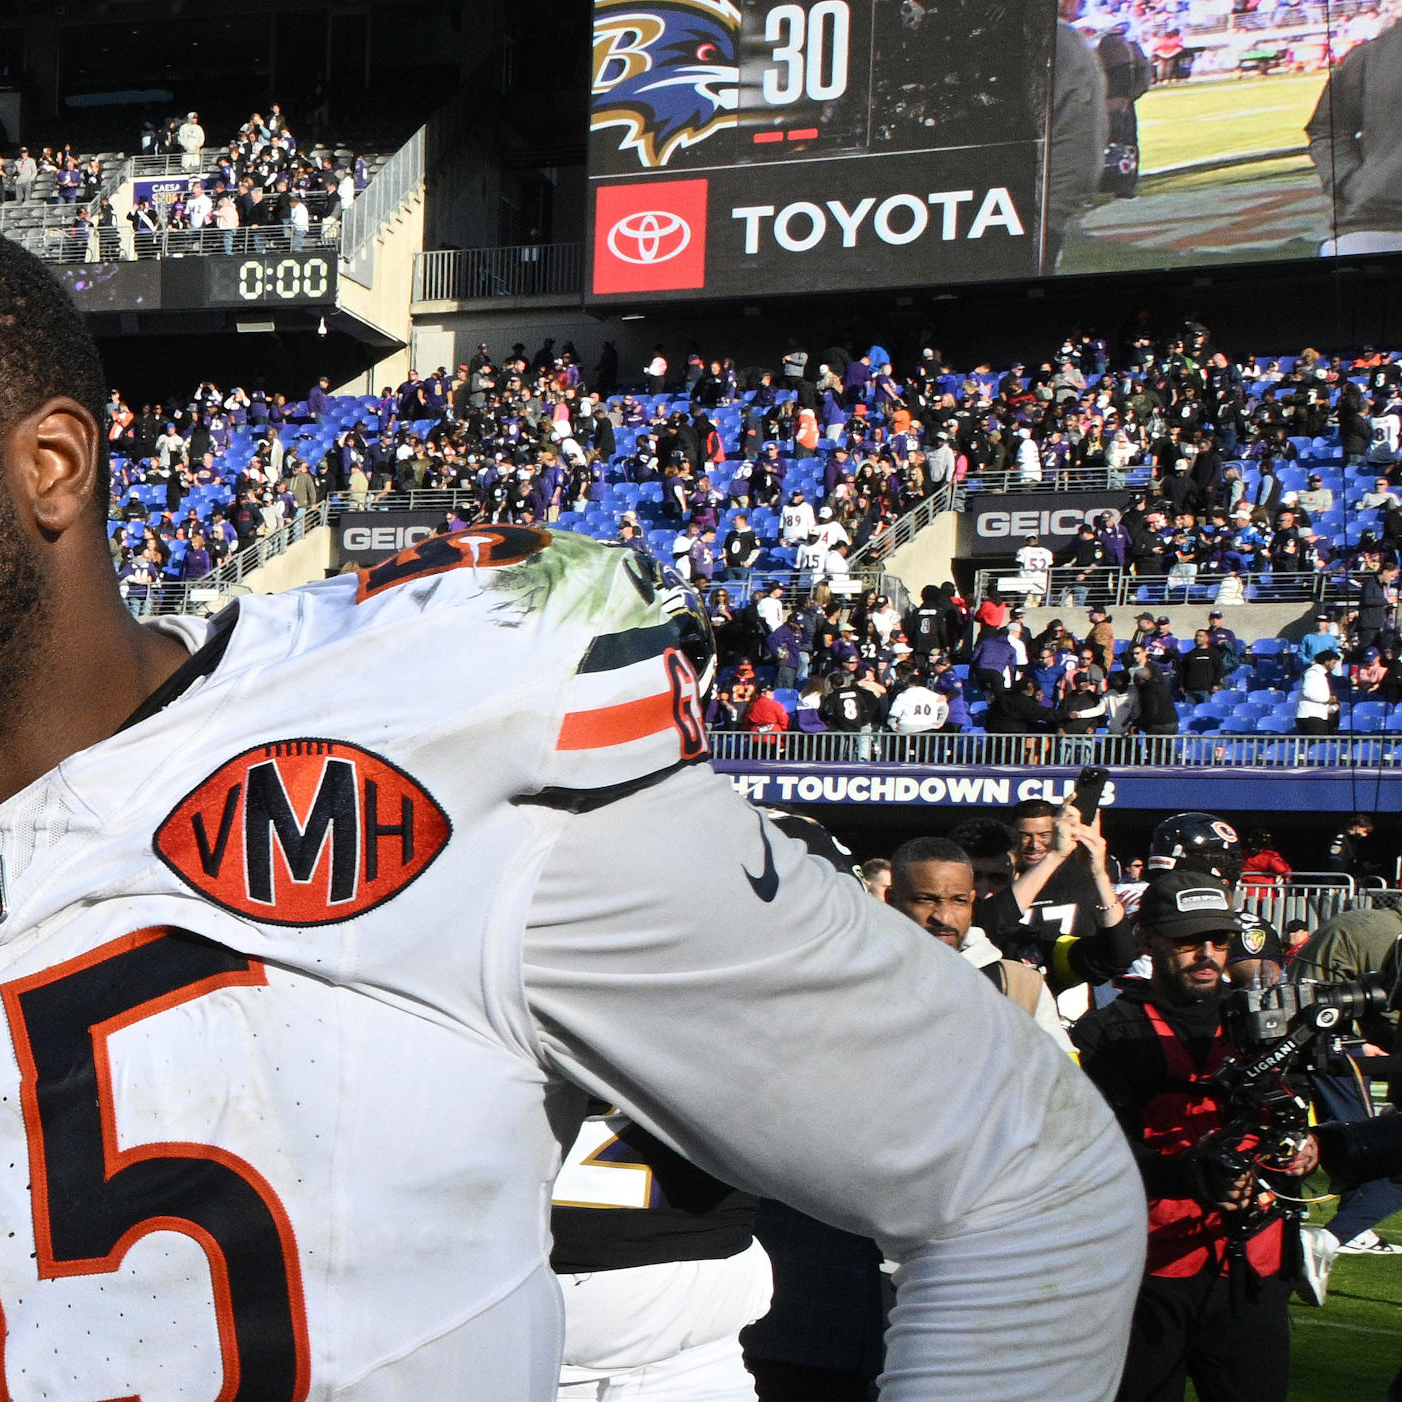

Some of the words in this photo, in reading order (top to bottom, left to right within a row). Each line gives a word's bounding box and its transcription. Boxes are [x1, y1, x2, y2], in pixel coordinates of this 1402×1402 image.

[763, 0, 851, 104] 30
[732, 187, 1024, 256] TOYOTA
[239, 257, 327, 300] 0:00
[344, 526, 432, 551] GEIC
[777, 775, 1012, 803] TOUCHDOWN
[191, 757, 413, 906] VMH
[1246, 1039, 1296, 1078] LIGRANI
